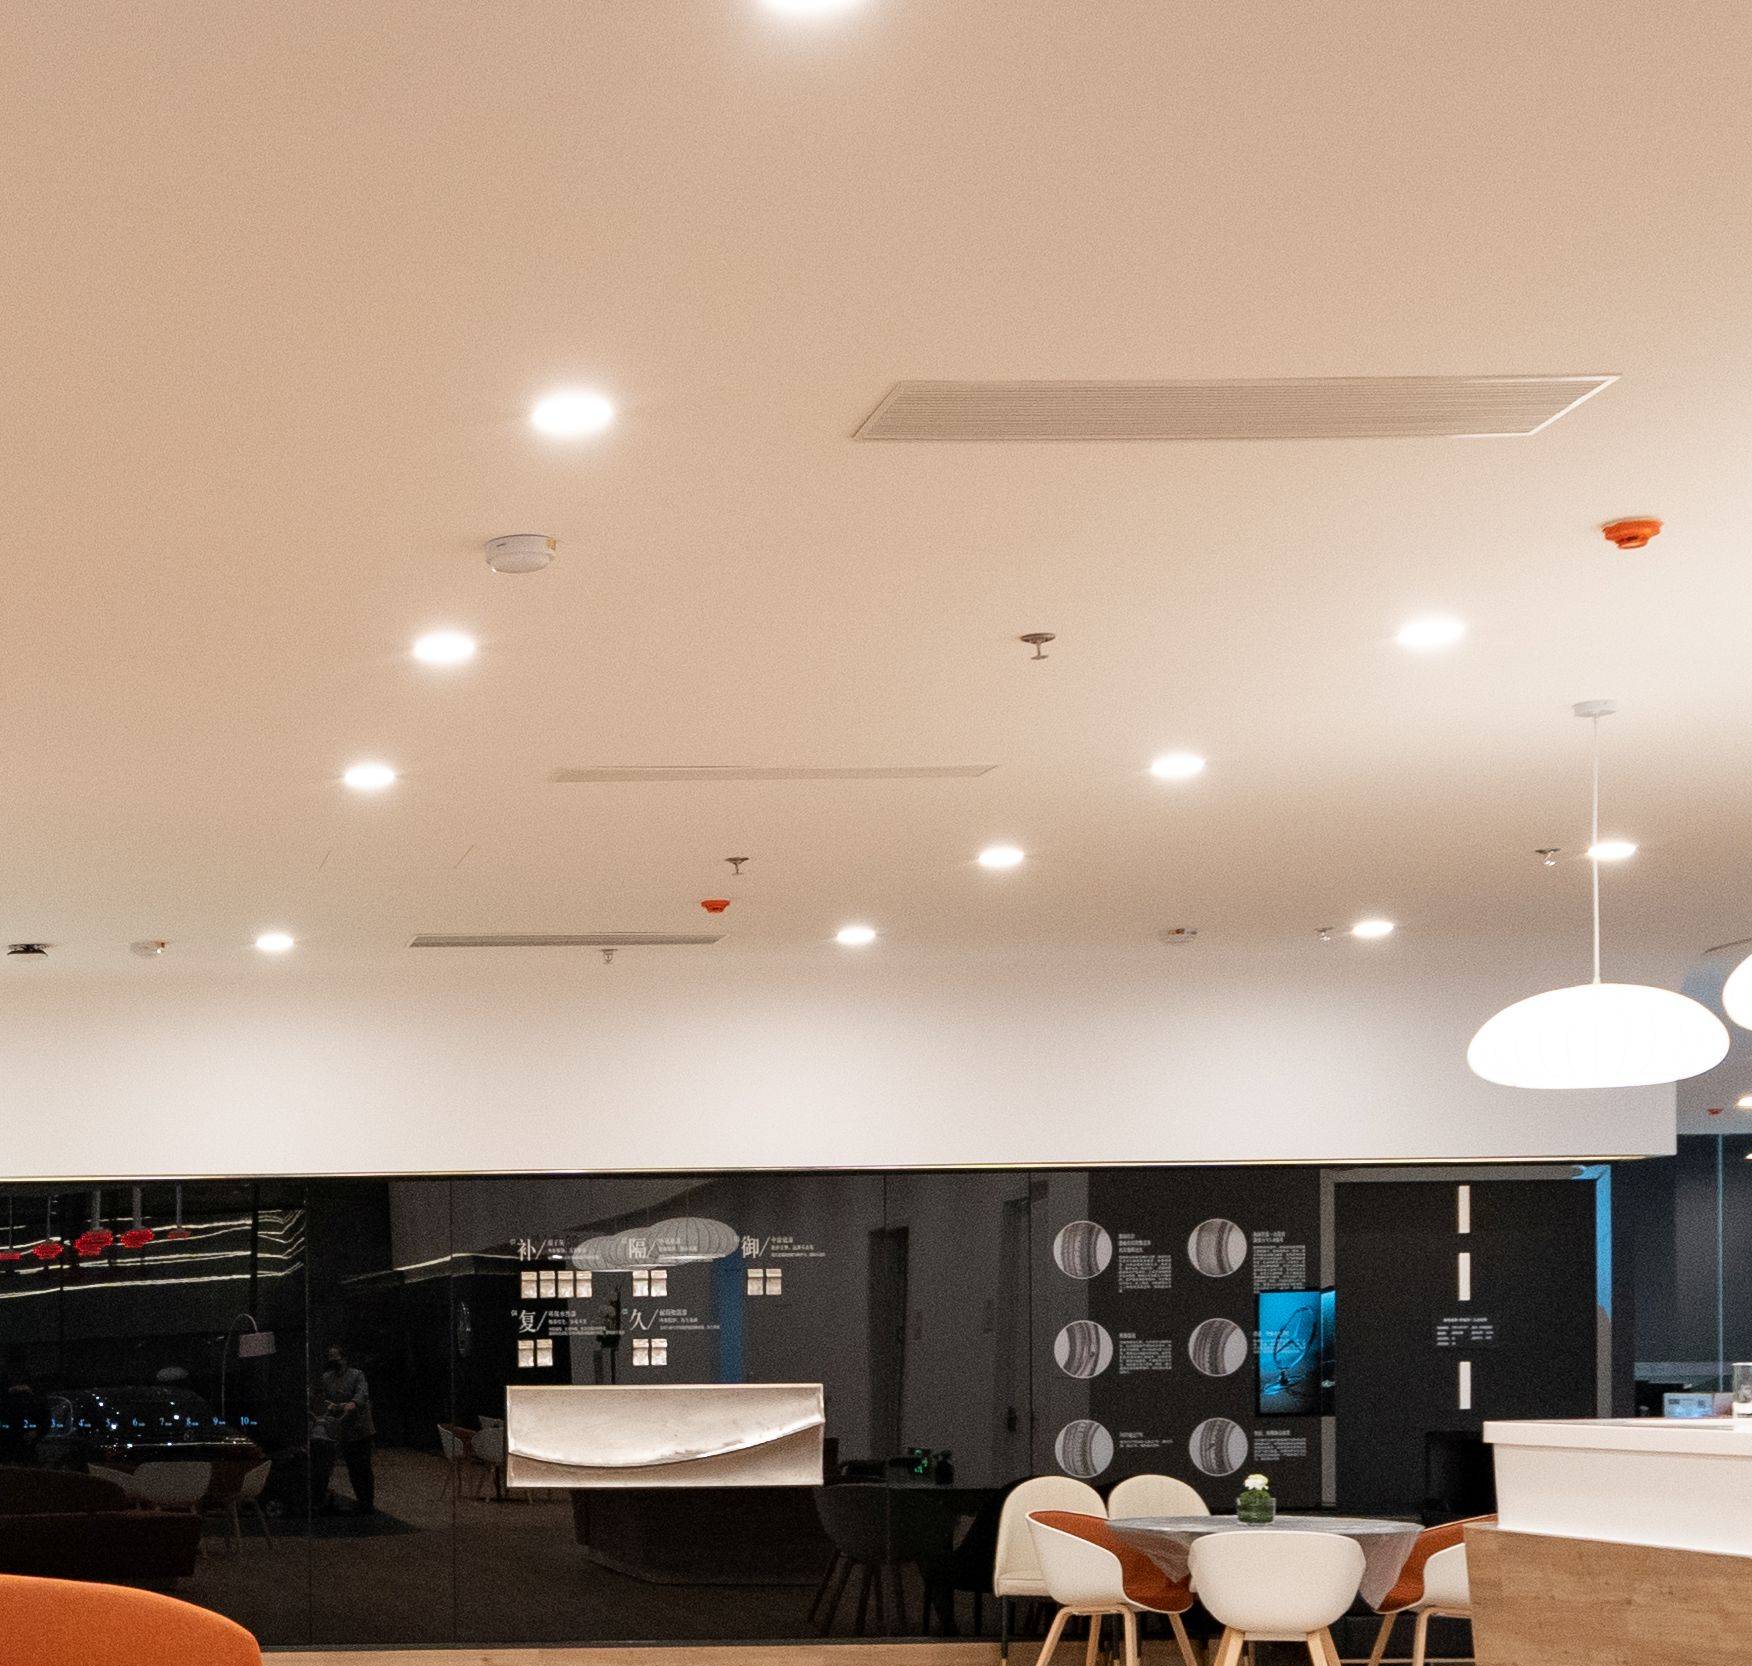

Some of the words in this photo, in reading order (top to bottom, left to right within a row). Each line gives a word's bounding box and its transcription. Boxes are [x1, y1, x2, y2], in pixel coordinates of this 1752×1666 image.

[741, 1236, 759, 1258] 御
[519, 1309, 537, 1334] 复
[629, 1308, 648, 1331] 久
